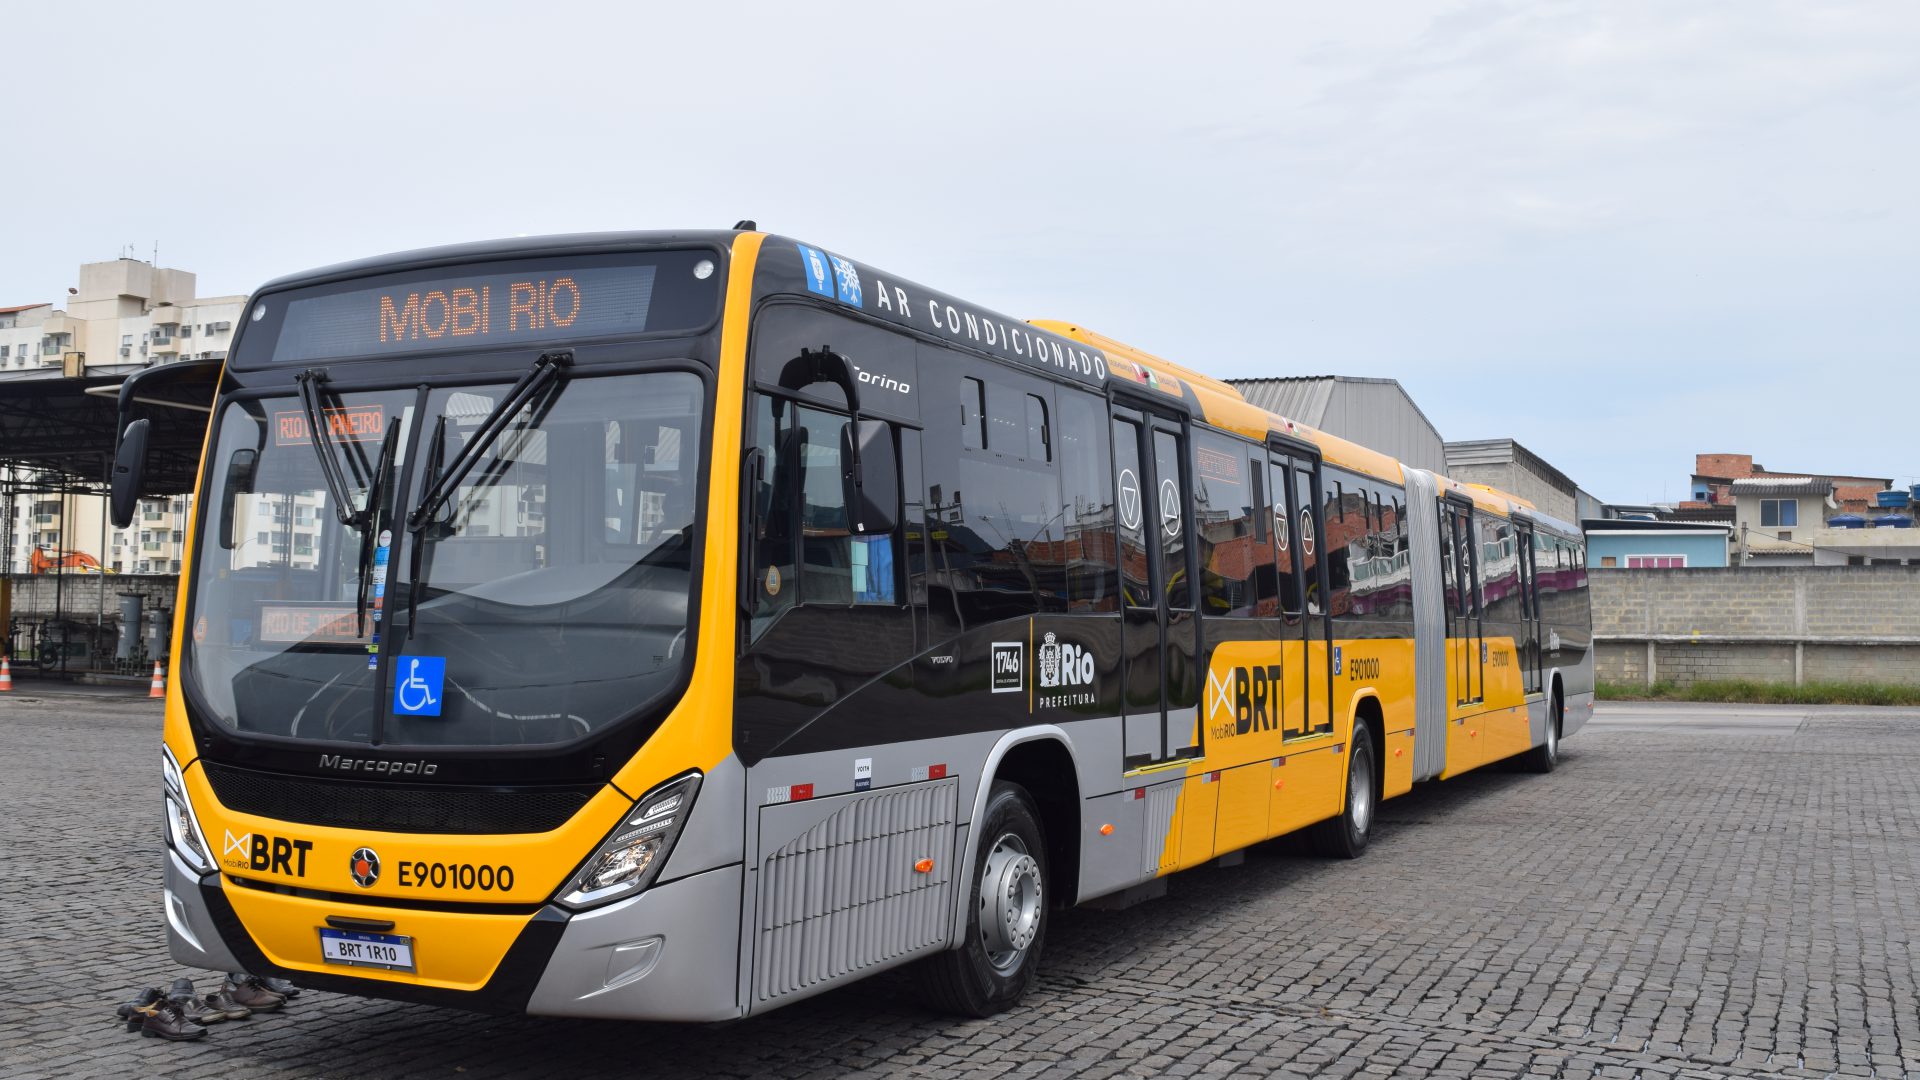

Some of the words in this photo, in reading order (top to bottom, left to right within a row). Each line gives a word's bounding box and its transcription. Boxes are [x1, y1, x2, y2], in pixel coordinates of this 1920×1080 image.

[380, 286, 489, 342] MOBI
[510, 277, 580, 332] RIO
[876, 280, 911, 318] AR
[929, 299, 1105, 380] CONDICIONADO
[853, 366, 910, 393] orino
[280, 417, 302, 438] RIO
[328, 411, 381, 436] JANEIRO
[930, 655, 953, 664] VOLVO
[995, 651, 1019, 674] 1746
[1061, 643, 1095, 686] Rio
[1350, 657, 1380, 681] E901000
[1039, 692, 1095, 708] PREFEITURA
[1235, 664, 1281, 735] BRT
[318, 754, 438, 776] Marcopolo
[223, 858, 249, 870] MobiRIO
[250, 833, 313, 877] BRT
[398, 861, 515, 892] E901000
[339, 942, 362, 958] BRT
[366, 945, 397, 962] 1R10
